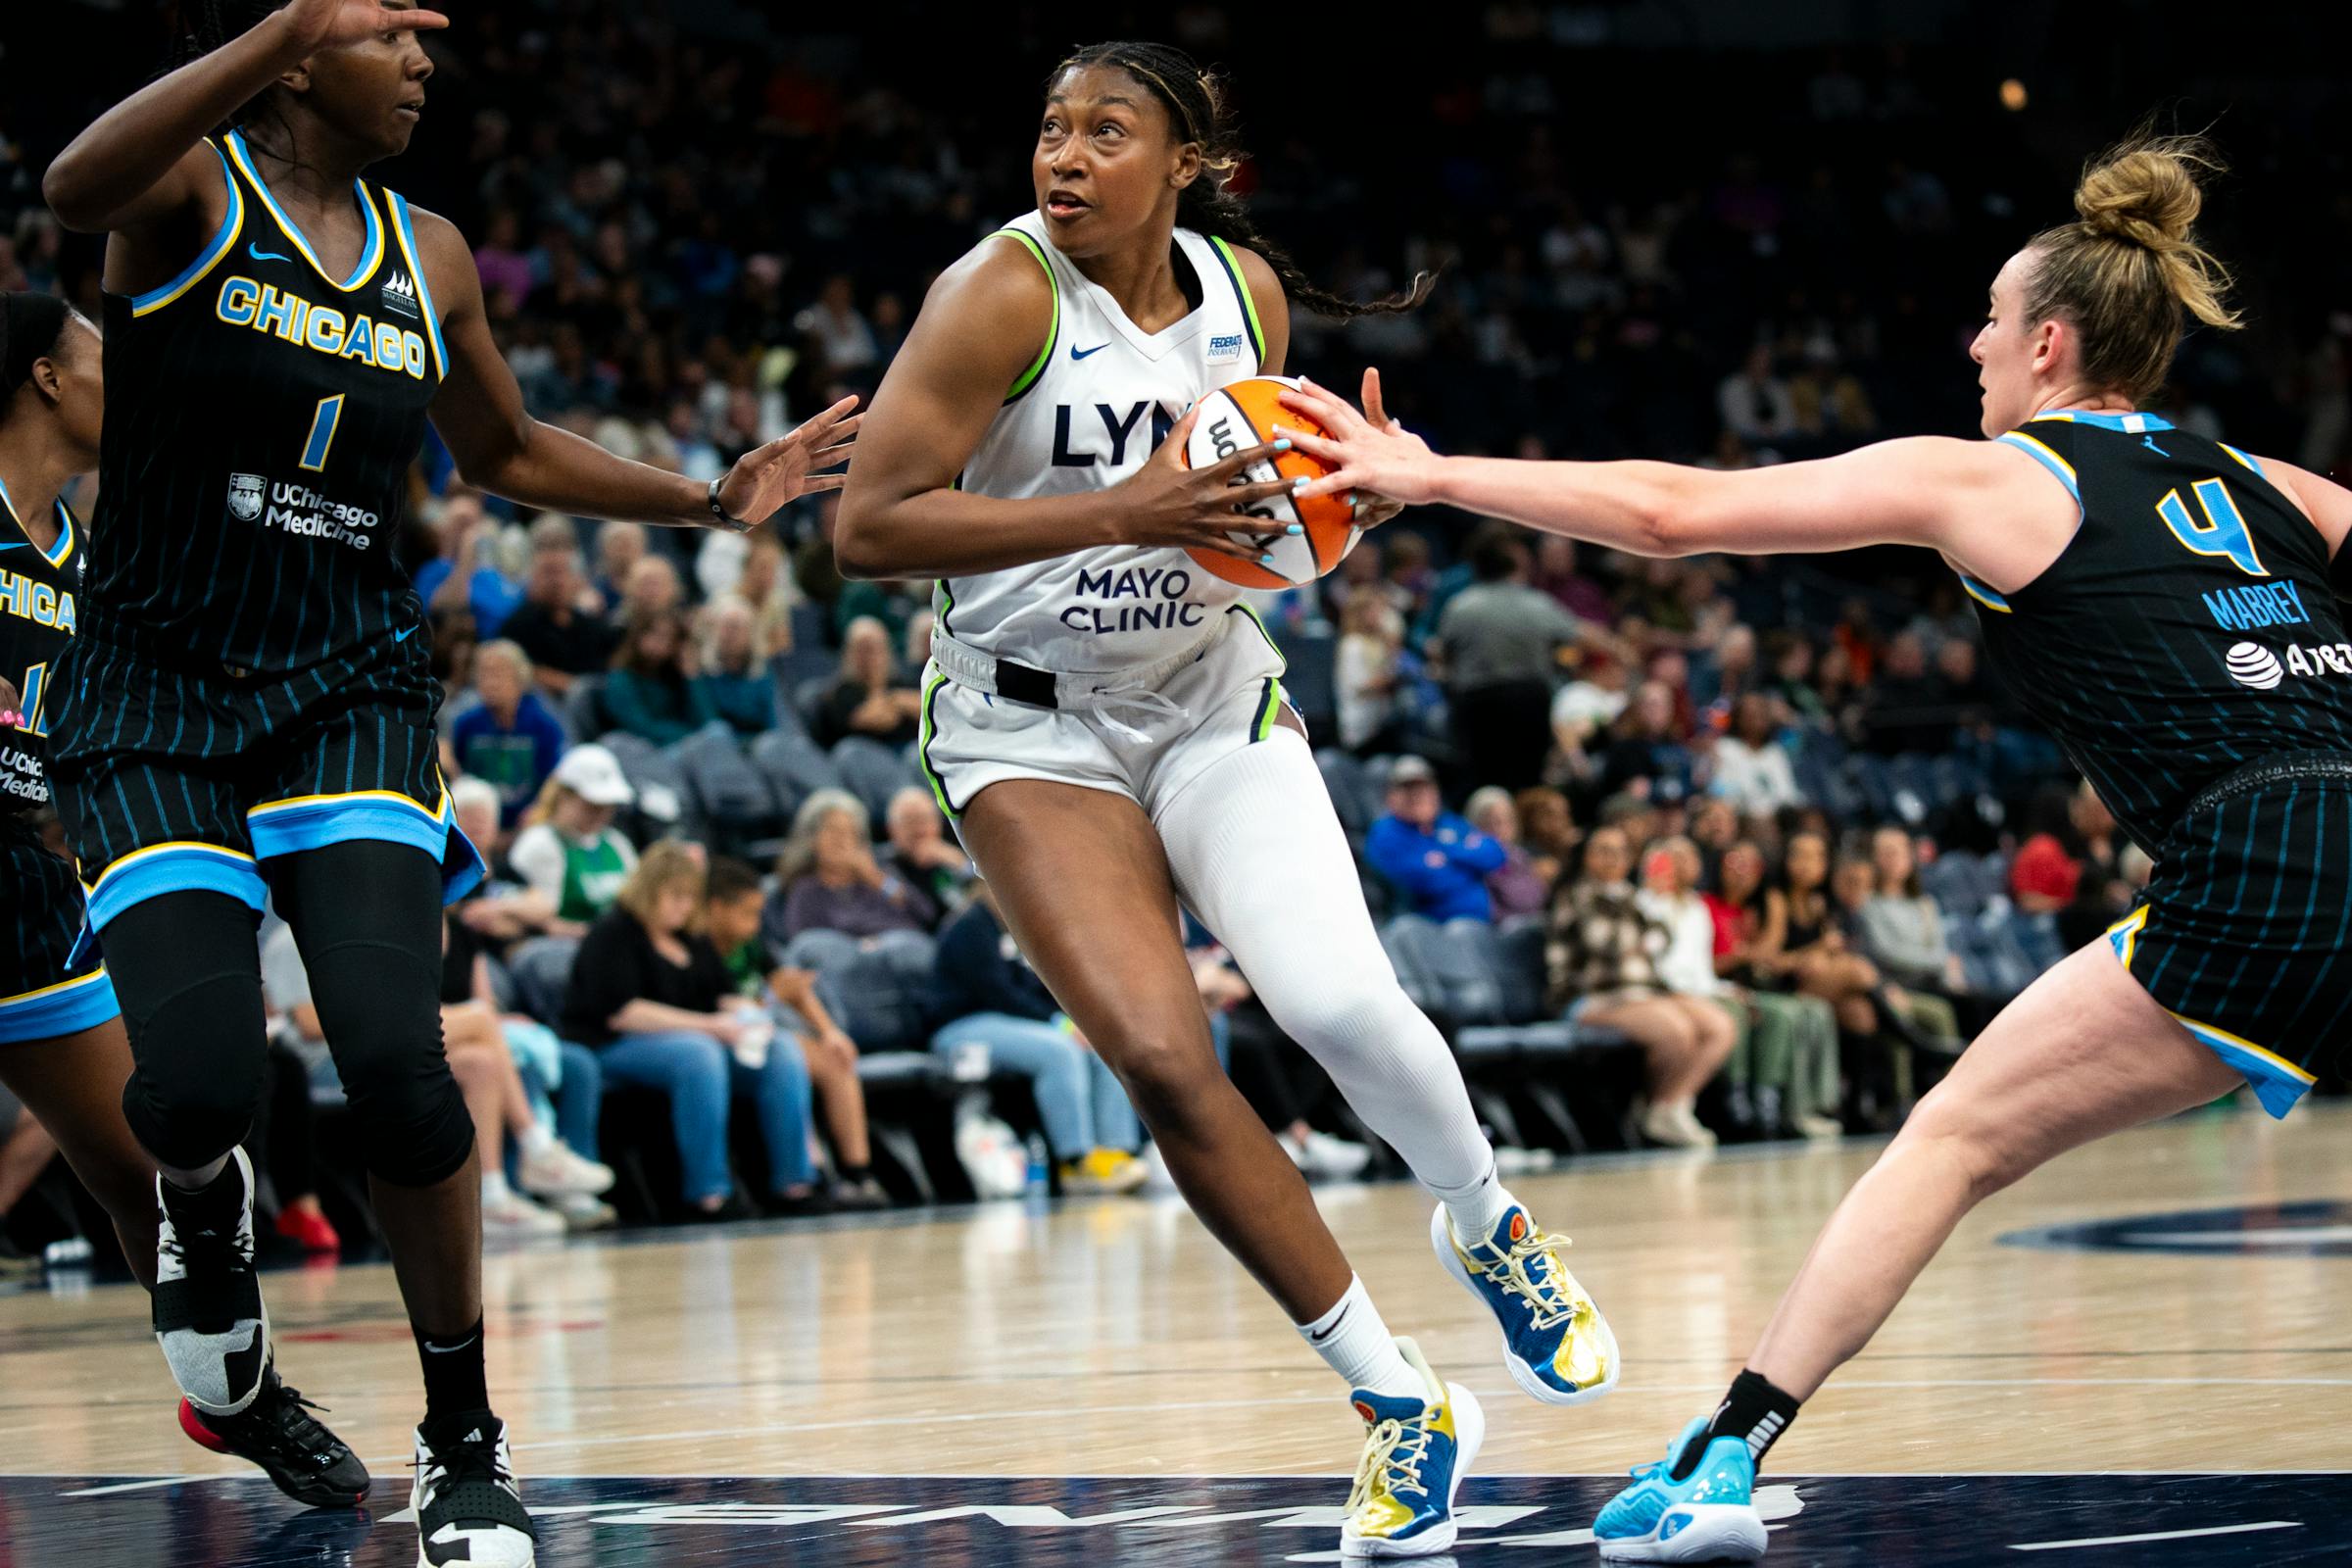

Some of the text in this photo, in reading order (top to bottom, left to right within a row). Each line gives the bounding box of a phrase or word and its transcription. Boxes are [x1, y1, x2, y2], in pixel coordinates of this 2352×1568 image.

[216, 274, 426, 380] CHICAGO
[298, 393, 345, 472] 1
[1052, 400, 1193, 466] LYN
[265, 505, 370, 550] Medicine
[271, 482, 378, 528] UChicago
[2155, 476, 2272, 576] 4
[0, 566, 76, 637] HICA
[1075, 567, 1191, 600] MAYO
[2201, 579, 2311, 631] MABREY
[1059, 601, 1206, 635] CLINIC
